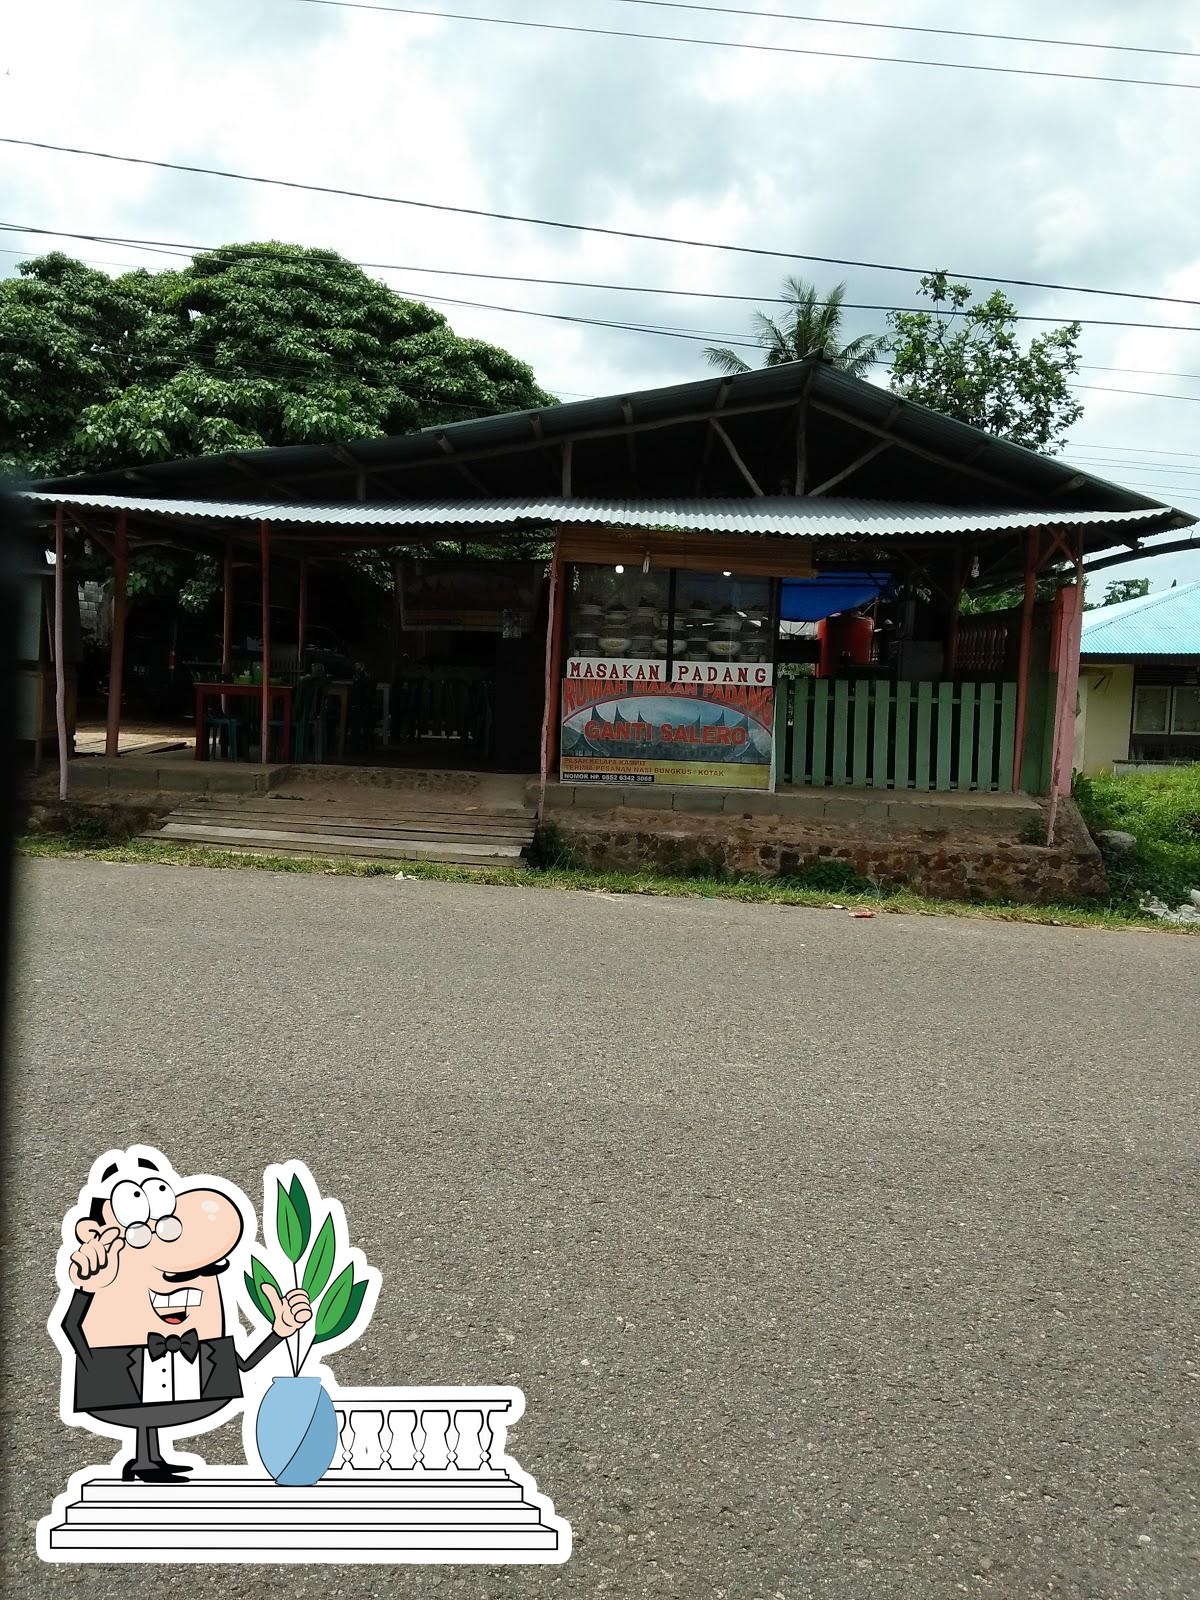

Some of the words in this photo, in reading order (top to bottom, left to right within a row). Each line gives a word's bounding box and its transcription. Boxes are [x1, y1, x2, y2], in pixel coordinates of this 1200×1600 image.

[570, 662, 660, 680] MASAKAN
[678, 665, 767, 683] PADANG
[563, 678, 628, 717] RUMAH
[633, 680, 698, 695] MAKAN
[703, 683, 774, 726] PADANG
[584, 719, 653, 741] GANTI
[659, 723, 748, 746] SALERO
